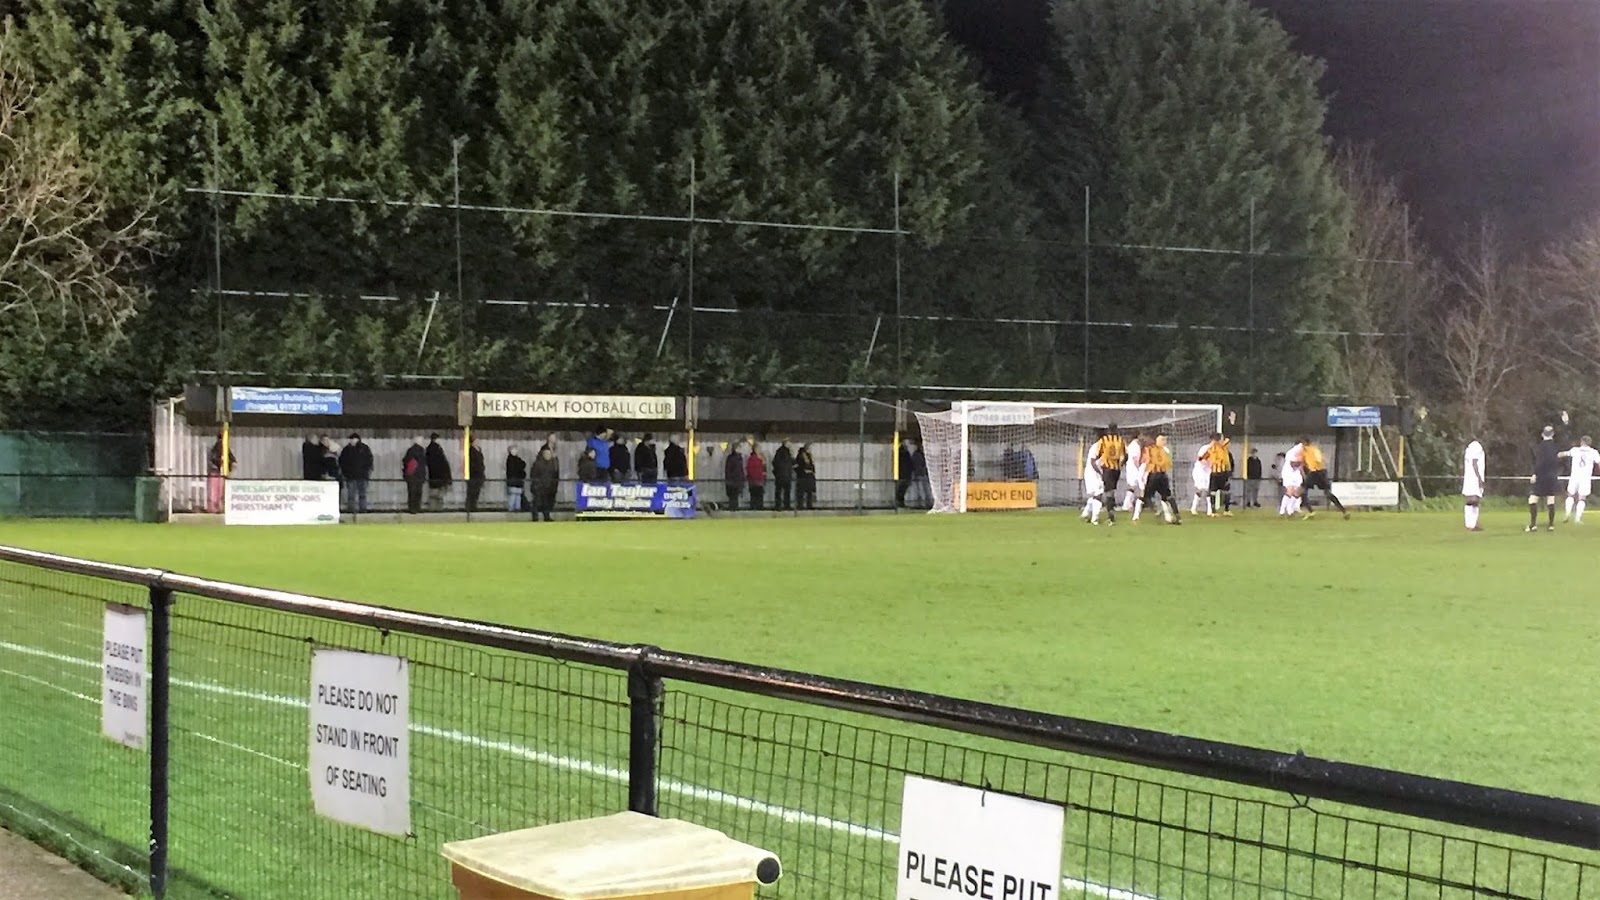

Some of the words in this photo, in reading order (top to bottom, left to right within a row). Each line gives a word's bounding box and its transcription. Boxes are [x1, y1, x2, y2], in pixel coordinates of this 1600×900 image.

[482, 399, 558, 413] MERSTHAM
[564, 401, 633, 414] FOOTBALL
[638, 402, 672, 415] CLUB
[230, 494, 271, 502] PROUDLY
[581, 484, 607, 497] Ian
[610, 484, 658, 500] Taylor
[966, 490, 1007, 501] HURCH
[1010, 490, 1034, 501] END
[230, 502, 282, 511] MERSTHAM
[284, 503, 294, 511] FC
[105, 640, 130, 661] PLEASE
[131, 646, 143, 664] PUT
[106, 664, 134, 685] RUBBISH
[135, 671, 142, 688] IN
[109, 688, 122, 707] THE
[123, 692, 138, 712] BINS
[318, 684, 356, 710] PLEASE
[358, 692, 374, 710] DO
[376, 692, 398, 715] NOT
[316, 724, 348, 748] STAND
[350, 729, 361, 750] IN
[363, 732, 399, 758] FRONT
[326, 765, 340, 786] OF
[341, 769, 387, 798] SEATING
[906, 850, 994, 900] PLEASE
[1003, 874, 1052, 900] PUT
